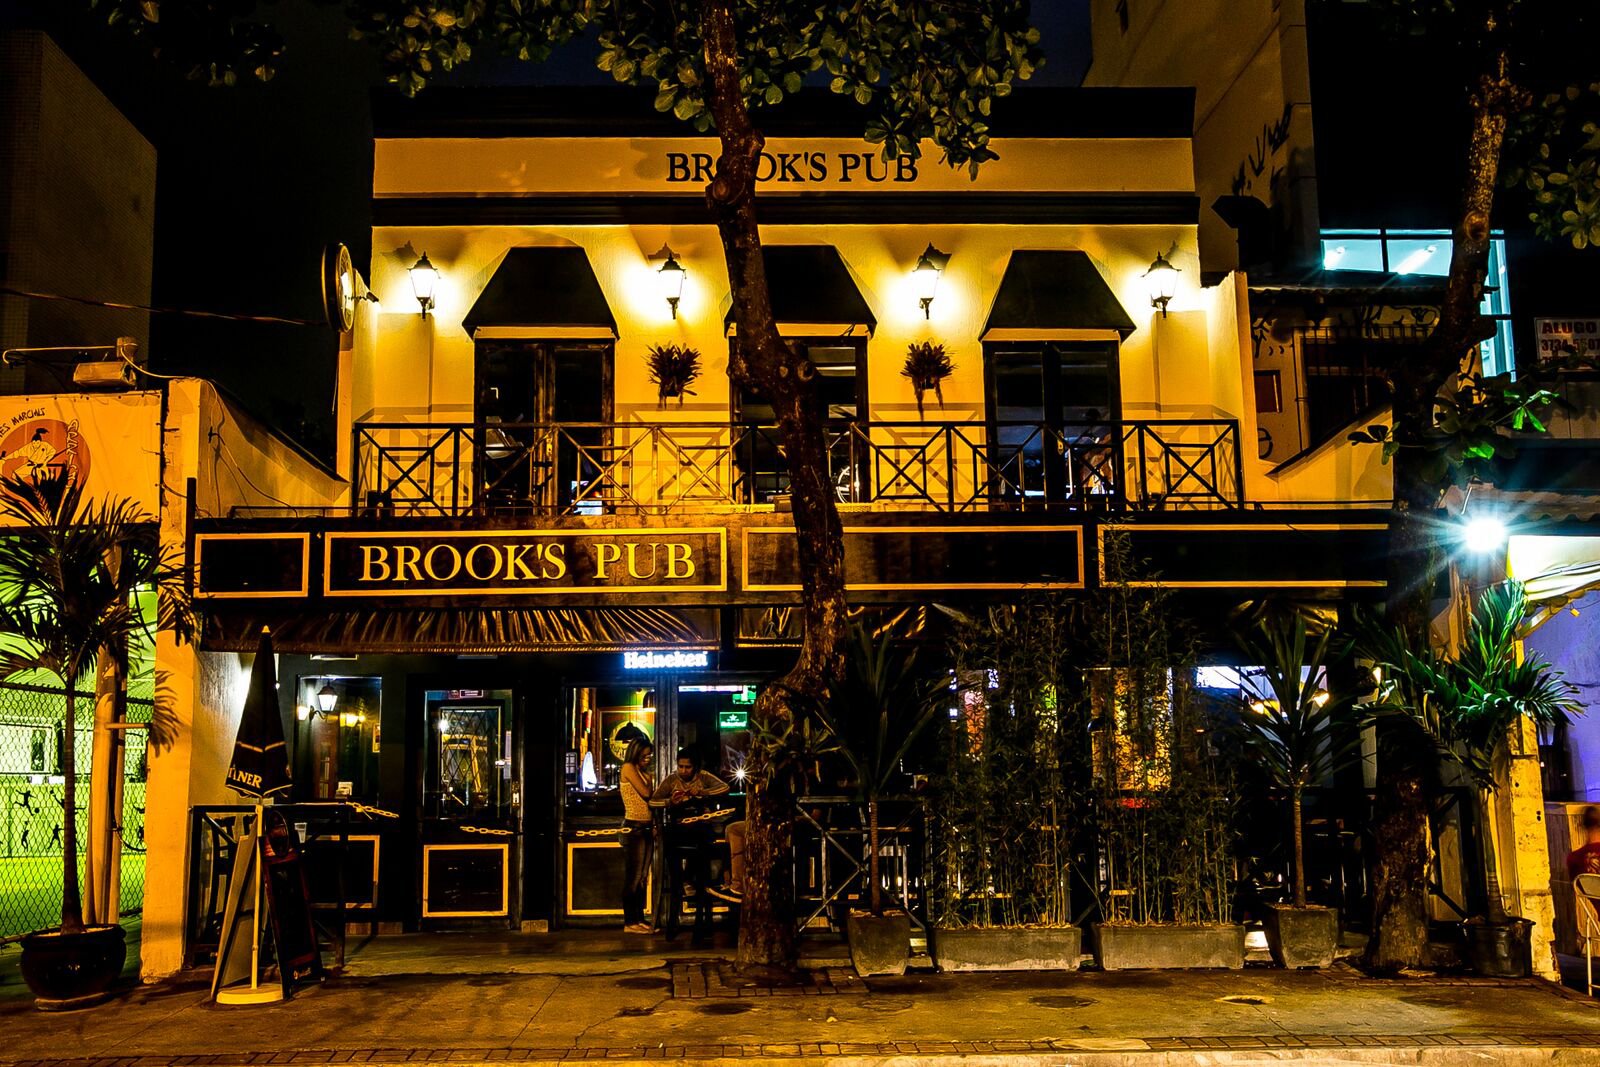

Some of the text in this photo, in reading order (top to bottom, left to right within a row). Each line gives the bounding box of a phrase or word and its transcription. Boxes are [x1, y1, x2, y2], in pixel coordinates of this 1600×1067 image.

[666, 152, 918, 182] BROK'S PUB
[1542, 321, 1597, 334] ALUGO
[358, 542, 696, 582] BROOK'S PUB
[623, 651, 708, 669] Heineken
